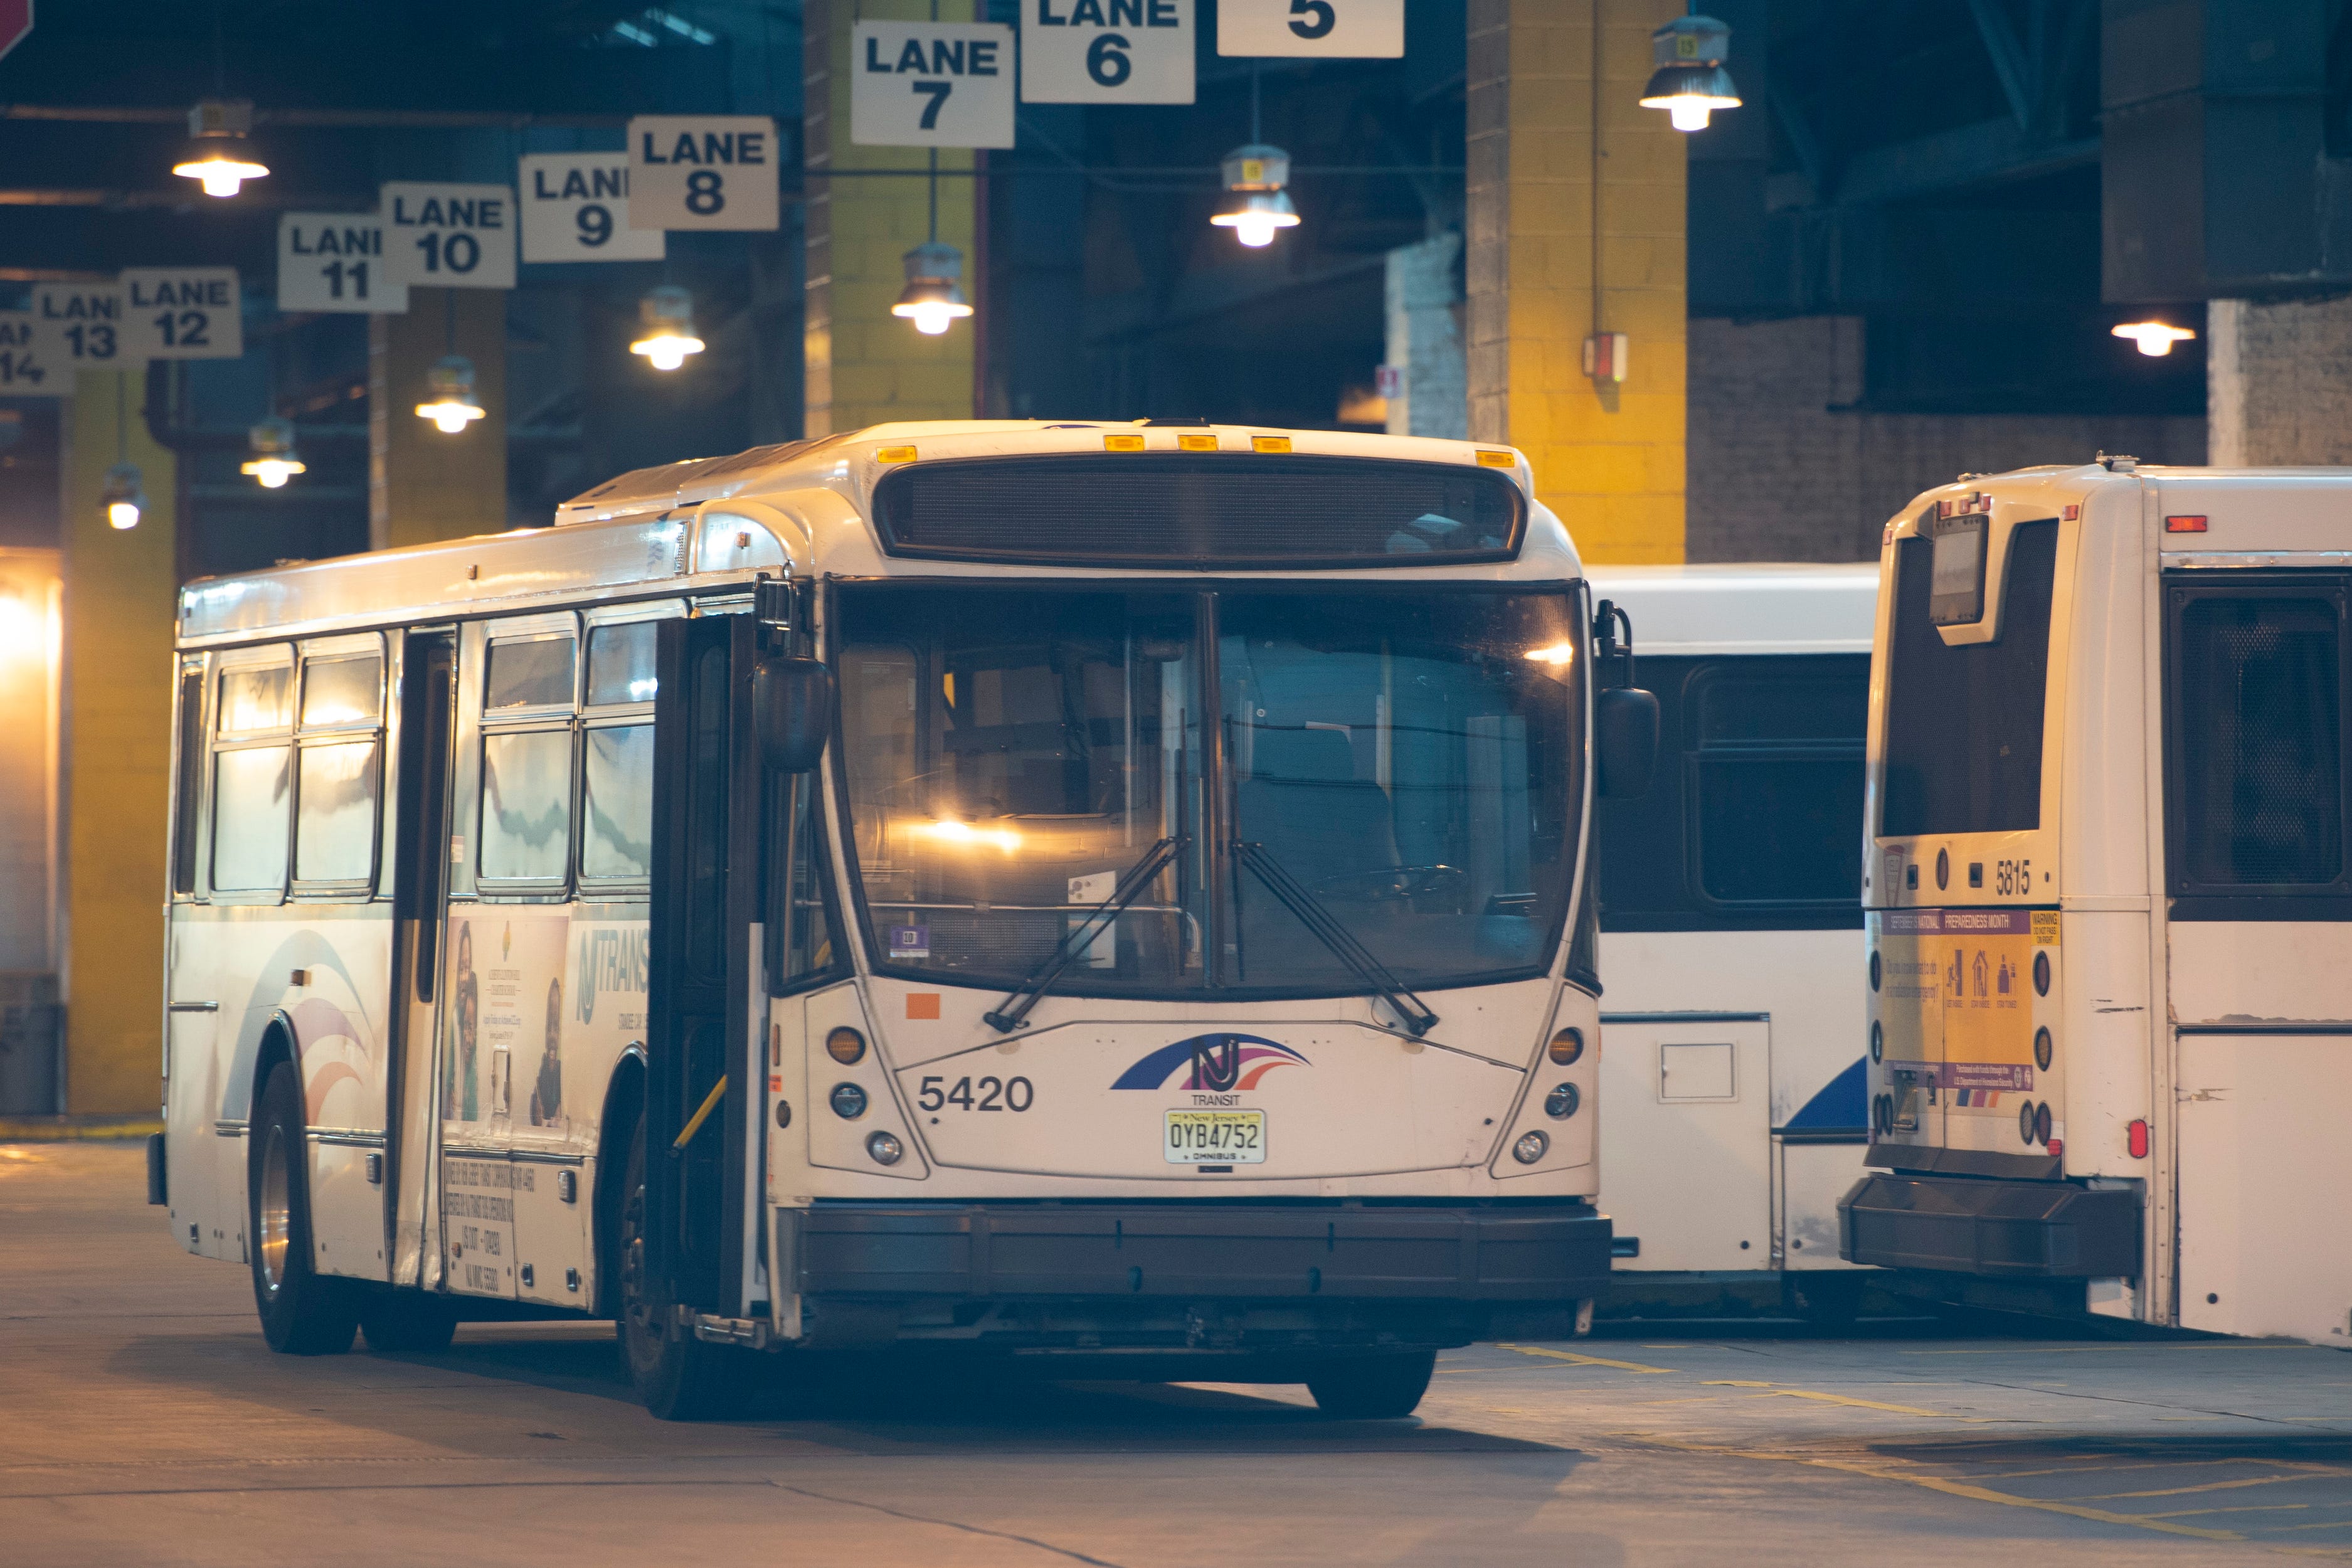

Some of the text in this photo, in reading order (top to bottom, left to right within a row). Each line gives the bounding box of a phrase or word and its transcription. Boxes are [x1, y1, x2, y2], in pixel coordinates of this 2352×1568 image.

[1038, 0, 1179, 27] LANE
[1287, 0, 1335, 40] 5
[866, 38, 999, 76] LANE
[1086, 33, 1131, 87] 6
[912, 81, 951, 130] 7
[643, 132, 765, 164] LANE
[534, 168, 628, 200] LAN
[685, 171, 724, 216] 8
[394, 198, 504, 228] LANE
[575, 204, 613, 246] 9
[291, 228, 381, 258] LAN
[417, 233, 480, 273] 10
[130, 281, 230, 307] LANE
[321, 262, 368, 299] 11
[65, 324, 117, 359] 13
[154, 311, 210, 347] 12
[0, 350, 45, 385] 14
[1996, 859, 2030, 896] 5815
[1945, 914, 1987, 928] PREPAREDNESS
[1988, 914, 2010, 928] MONTH
[2032, 913, 2057, 925] WARNING
[904, 933, 913, 943] 10
[1930, 960, 1936, 975] do
[1192, 1035, 1239, 1091] NJ
[918, 1076, 1034, 1112] 5420
[1192, 1094, 1241, 1106] TRANSIT
[1212, 1113, 1239, 1123] Jersey
